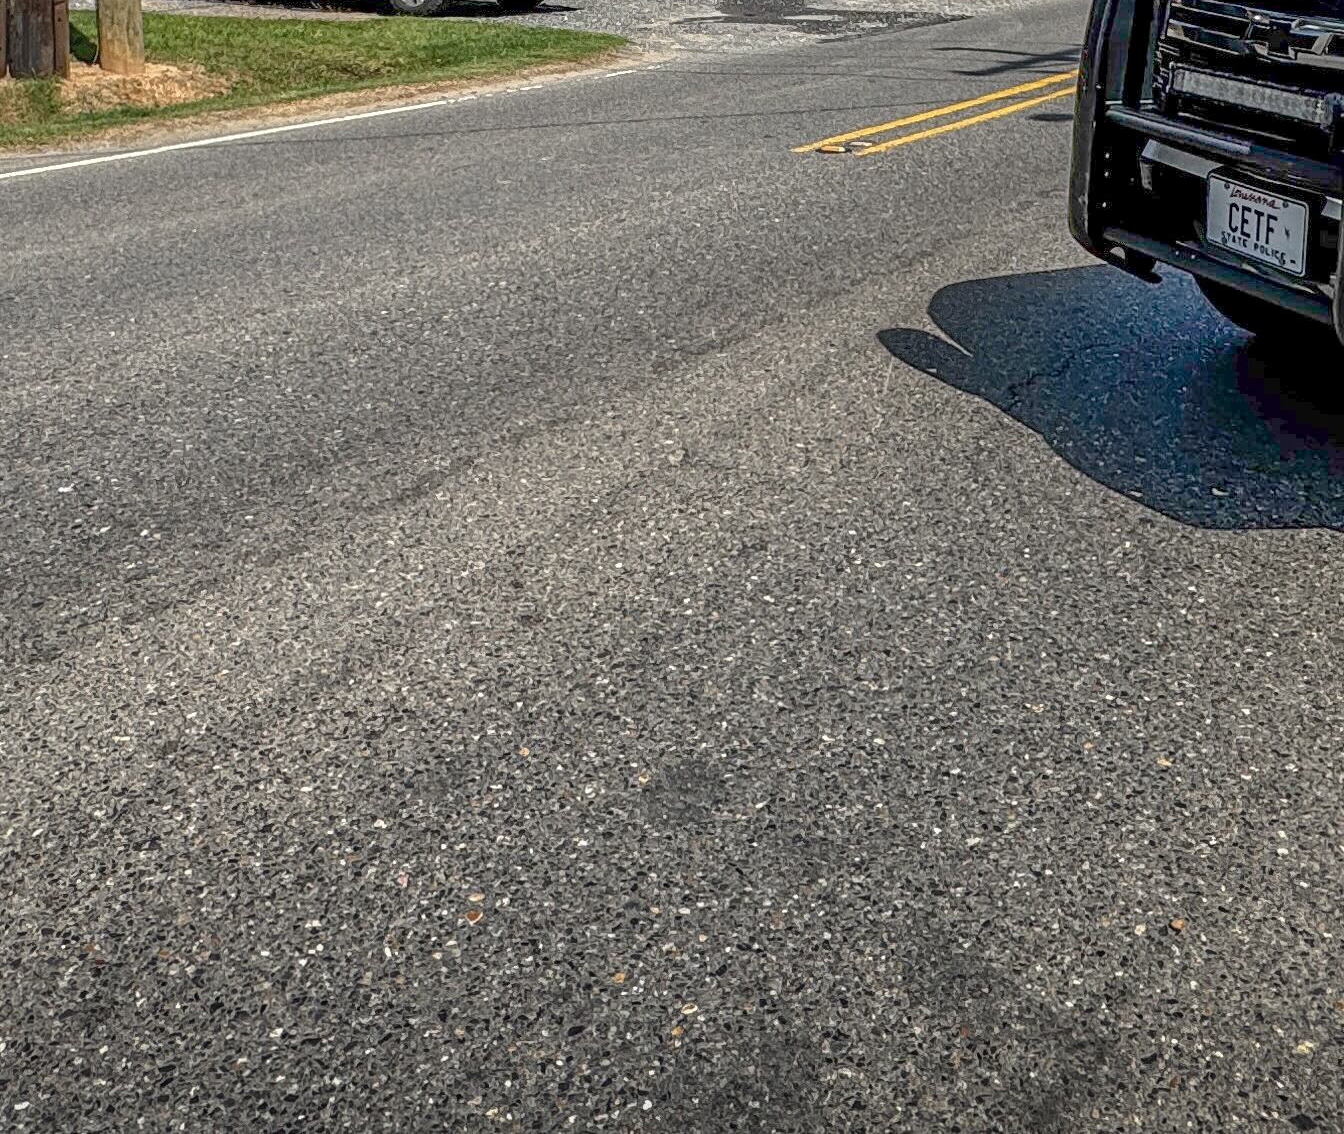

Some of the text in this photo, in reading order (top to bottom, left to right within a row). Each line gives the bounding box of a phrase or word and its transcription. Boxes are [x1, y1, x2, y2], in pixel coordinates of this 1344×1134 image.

[1229, 203, 1278, 245] CETF
[1221, 230, 1286, 265] STATE POLICE
